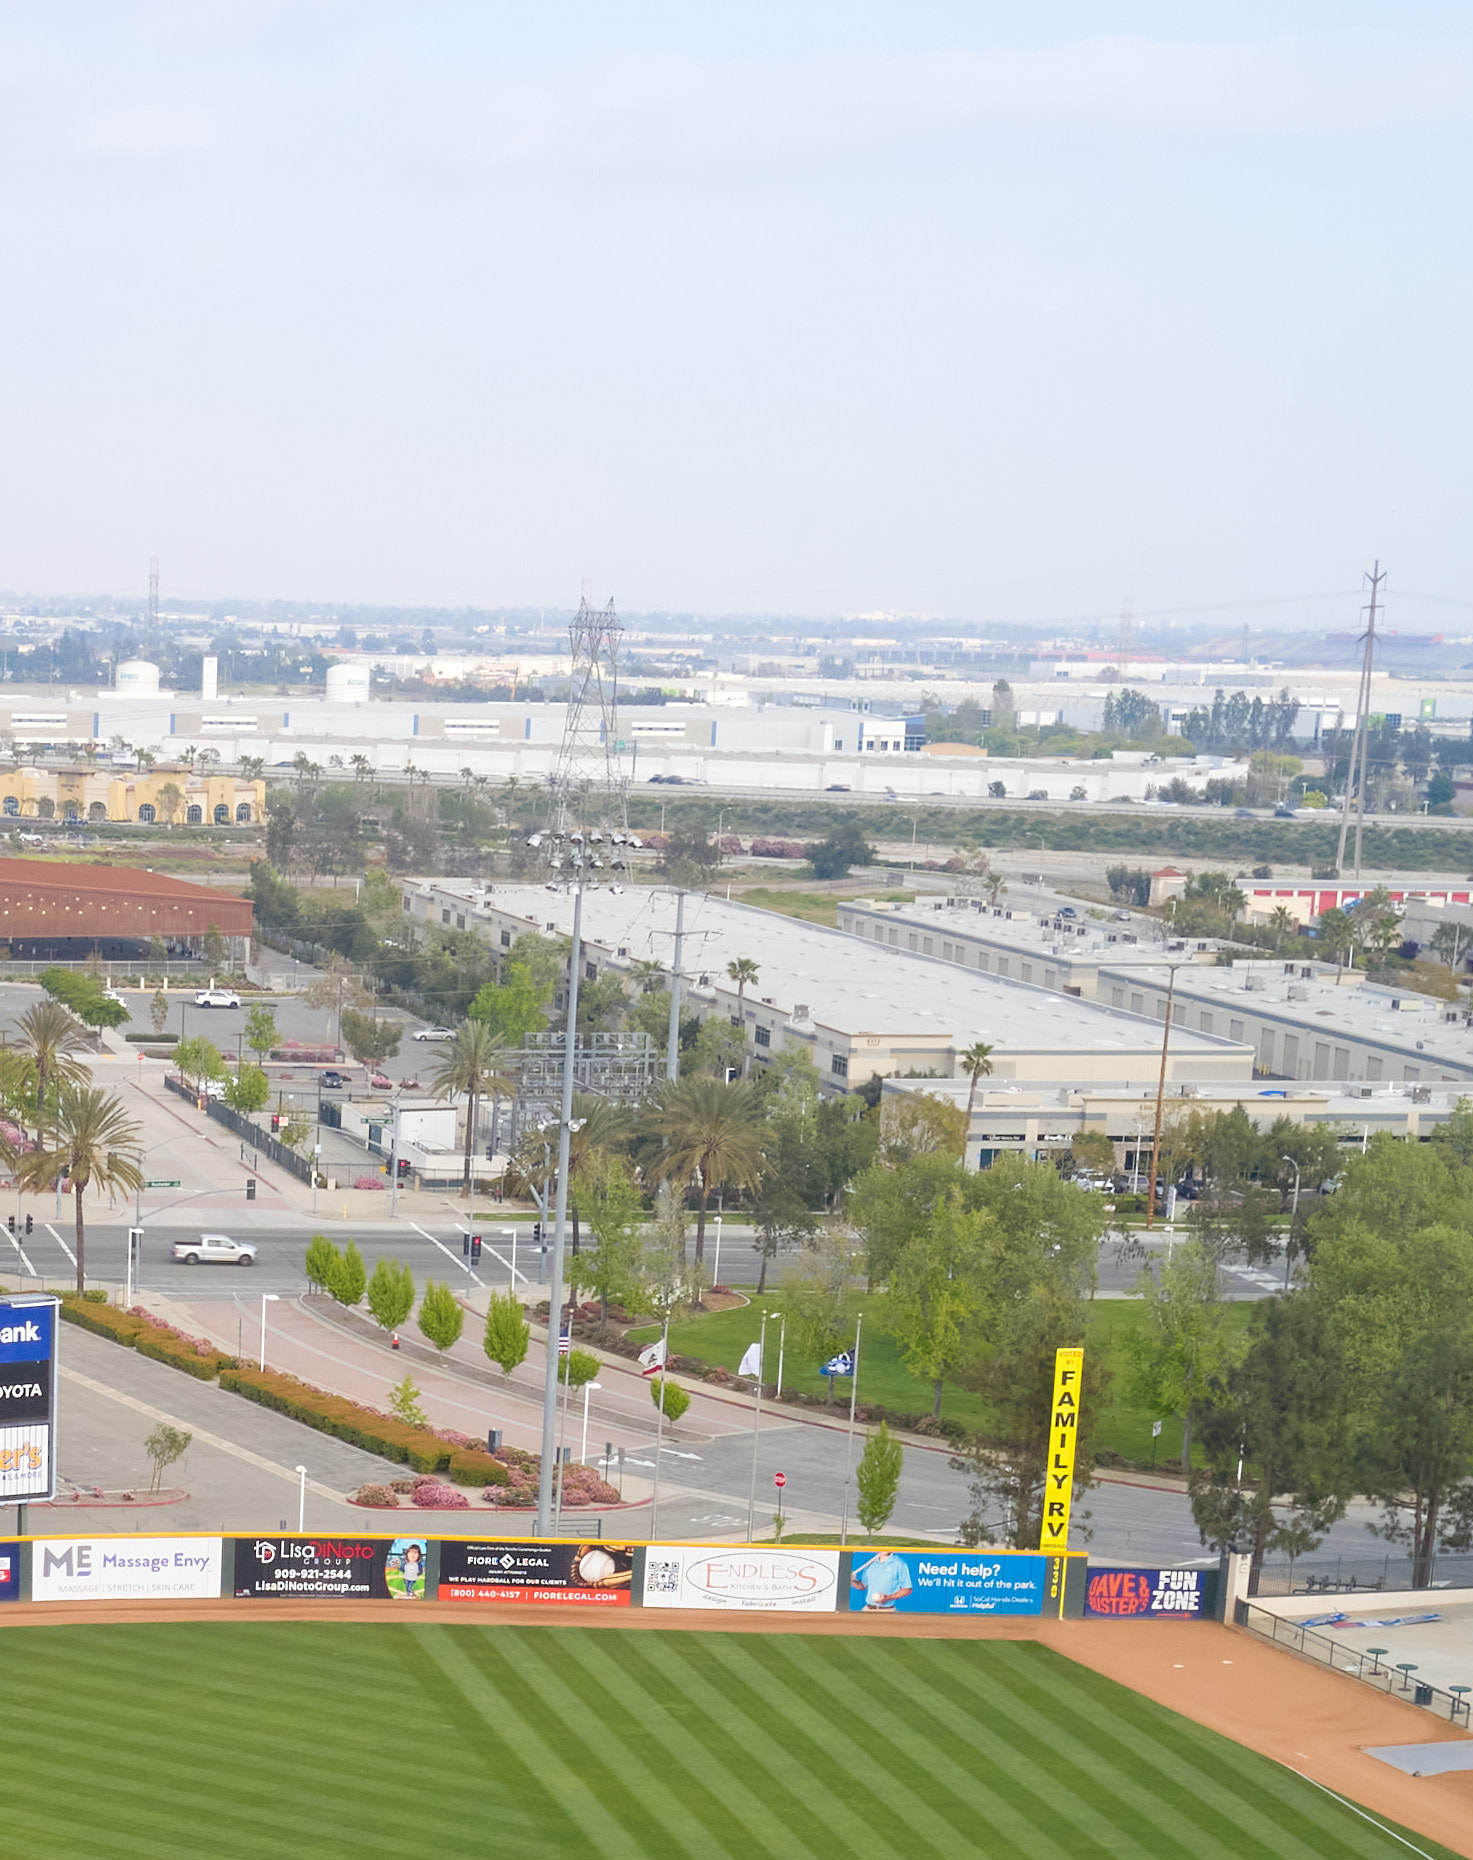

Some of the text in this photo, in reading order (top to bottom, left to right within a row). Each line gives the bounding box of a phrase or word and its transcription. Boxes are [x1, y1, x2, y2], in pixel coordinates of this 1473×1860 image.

[1052, 1370, 1075, 1490] FAMILY
[1047, 1502, 1065, 1538] RV
[103, 1553, 210, 1572] Massage Envy
[467, 1557, 549, 1567] FIORE LEGAL
[919, 1562, 1001, 1579] Need help?
[274, 1569, 352, 1579] 909-921-2544
[706, 1563, 817, 1591] ENDLESS
[1158, 1570, 1198, 1590] FUN
[59, 1583, 194, 1593] MASSAGE STRETCH SKIN CARE
[256, 1581, 369, 1593] LisaDiNotoGroup.com
[918, 1578, 1037, 1591] We'll hit it out of the park.
[1089, 1574, 1150, 1595] DAVE &
[450, 1588, 617, 1601] (800) 440-4157 FIORELEGAL.COM
[1151, 1590, 1200, 1610] ZONE
